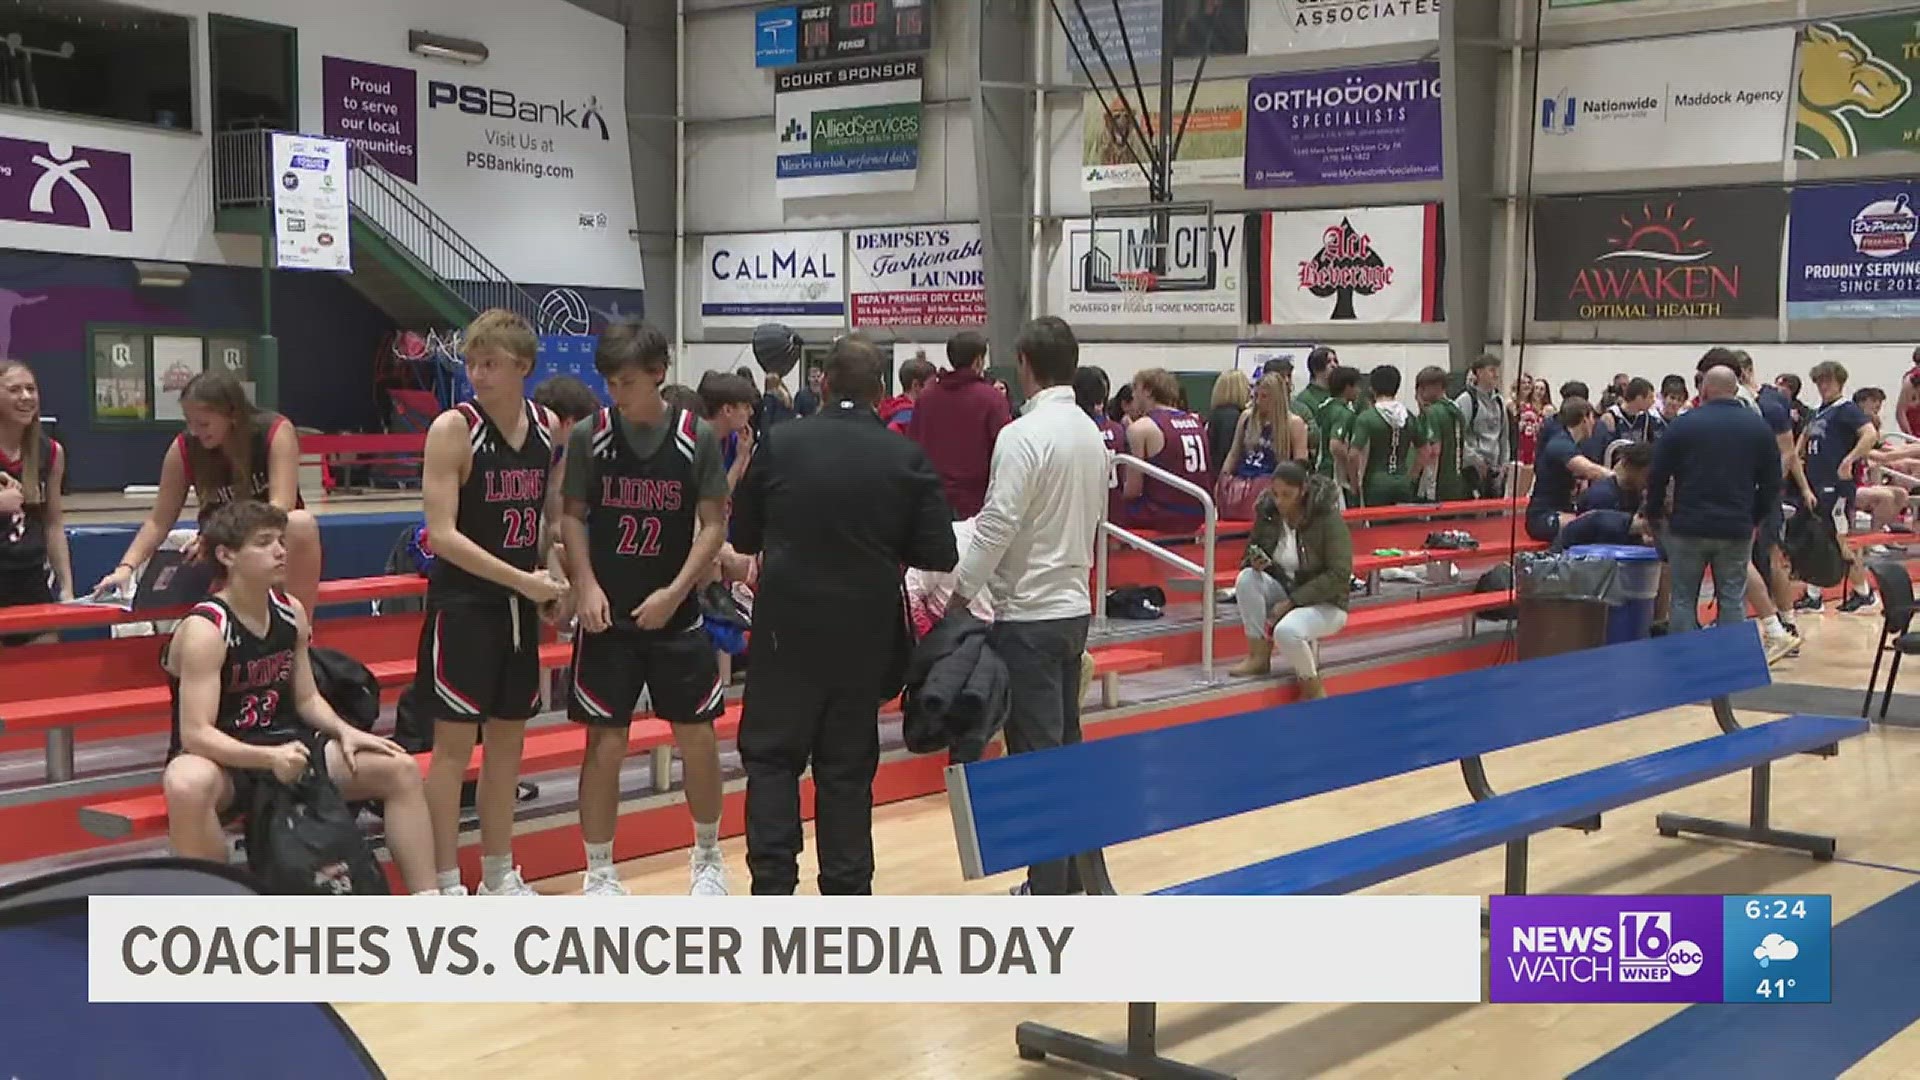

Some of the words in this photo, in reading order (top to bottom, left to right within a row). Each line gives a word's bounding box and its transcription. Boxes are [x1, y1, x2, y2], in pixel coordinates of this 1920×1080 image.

[1296, 1, 1440, 27] ASSOCIATES
[350, 76, 391, 95] Proud
[781, 71, 832, 88] COURT
[838, 62, 917, 82] SPONSOR
[343, 96, 357, 110] to
[362, 100, 398, 115] serve
[428, 80, 578, 128] PSBank
[1583, 97, 1658, 113] Nationwide
[1674, 91, 1731, 107] Maddock
[1736, 89, 1784, 105] Agency
[341, 118, 364, 130] our
[368, 117, 401, 135] local
[814, 114, 918, 139] AlliedServices
[1292, 107, 1406, 129] SPECIALISTS
[352, 138, 413, 157] munities
[485, 128, 516, 148] Visit
[519, 132, 537, 151] Us
[541, 138, 554, 152] at
[467, 151, 574, 180] PSBanking.com
[857, 230, 950, 250] DEMPSEY'S
[1175, 225, 1236, 268] CITY
[1323, 225, 1371, 259] Ace
[911, 270, 984, 287] LAUNDR
[1298, 260, 1394, 292] Beverage
[1569, 265, 1740, 300] AWAKEN
[1805, 263, 1862, 279] PROUDLY
[888, 294, 928, 304] PREMIER
[931, 293, 950, 303] DRY
[952, 292, 984, 303] CLEAN
[1840, 280, 1880, 293] SINCE
[1069, 304, 1110, 313] POWERED
[1111, 303, 1122, 313] BY
[1155, 303, 1181, 313] HOME
[1184, 303, 1236, 313] MORTGAGE
[1580, 304, 1646, 318] OPTIMAL
[1656, 303, 1721, 317] HEALTH
[857, 316, 880, 326] PROUD
[882, 316, 922, 325] SUPPORTER
[923, 316, 932, 325] OF
[935, 315, 957, 325] LOCAL
[1180, 434, 1206, 473] 51
[601, 476, 682, 511] LIONS
[503, 507, 537, 548] 23
[616, 515, 661, 556] 22
[229, 649, 294, 691] LIONS
[235, 690, 280, 729] 33
